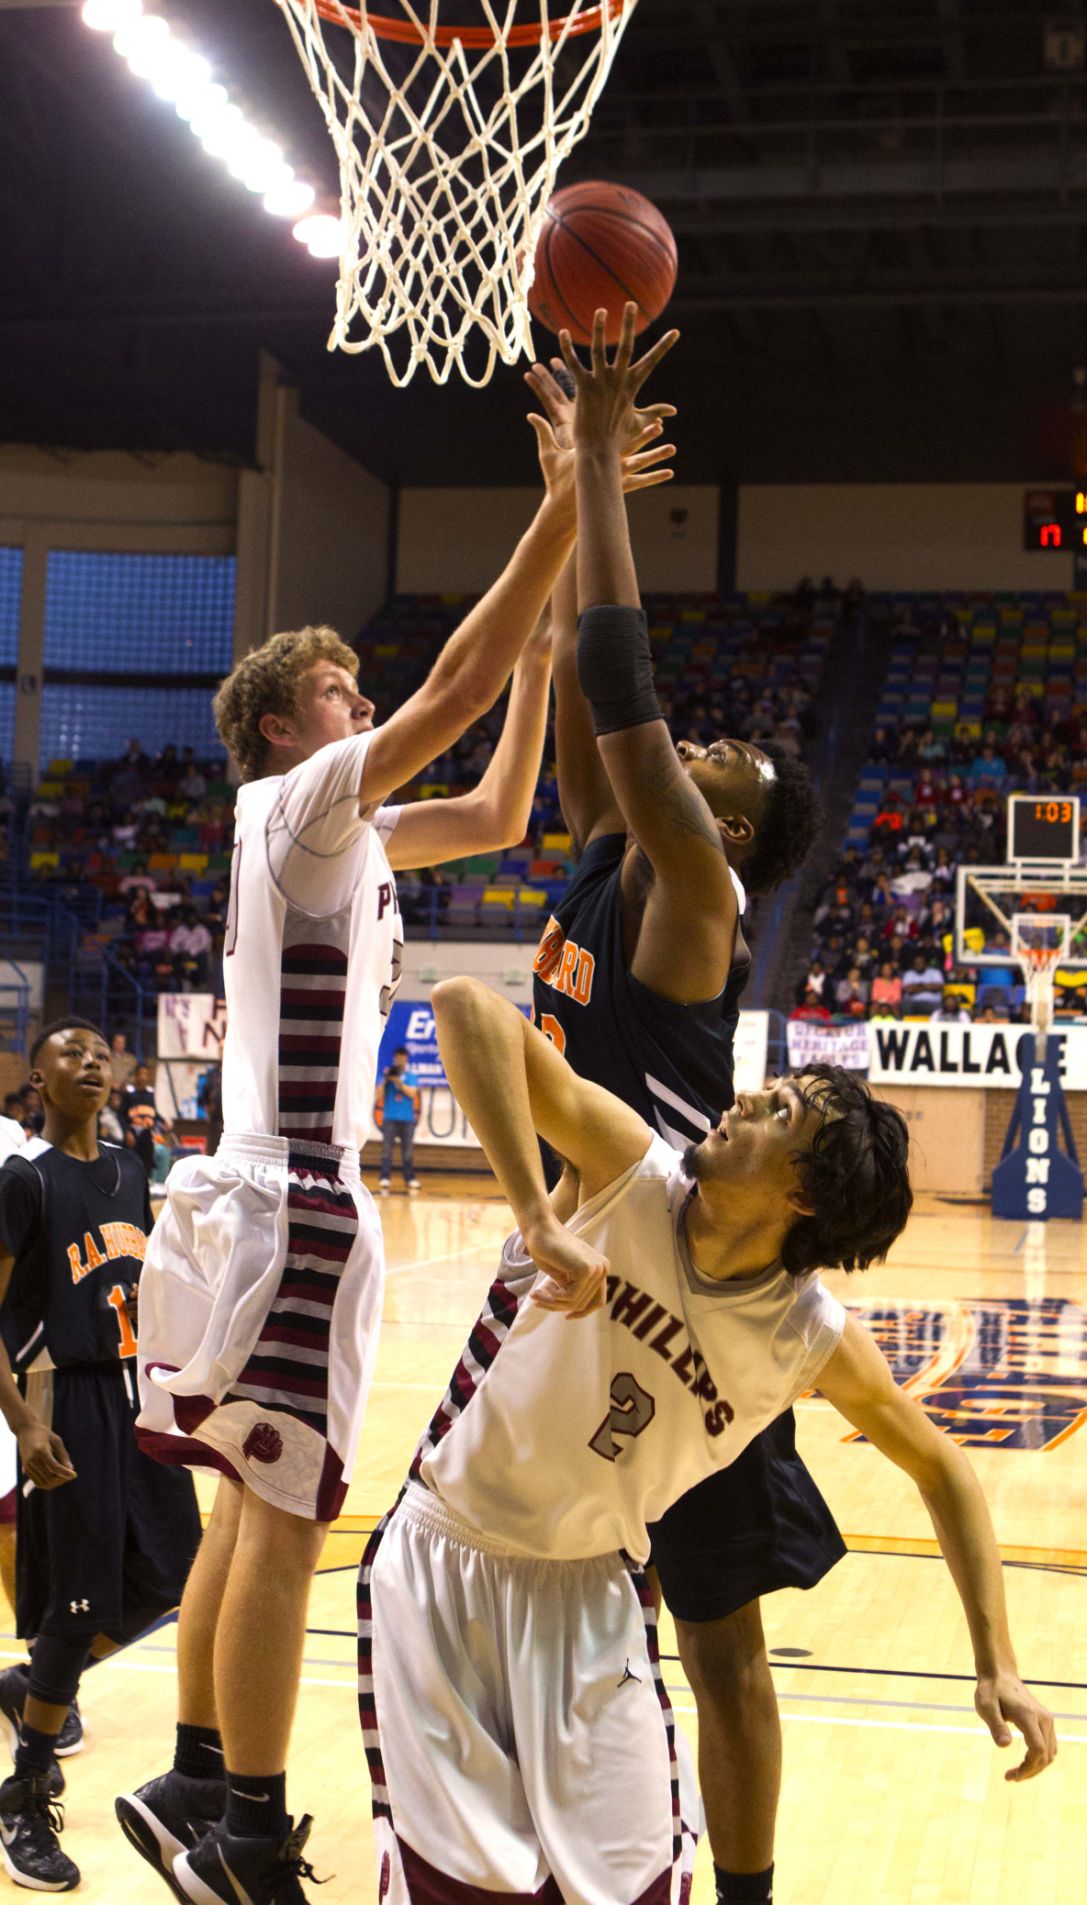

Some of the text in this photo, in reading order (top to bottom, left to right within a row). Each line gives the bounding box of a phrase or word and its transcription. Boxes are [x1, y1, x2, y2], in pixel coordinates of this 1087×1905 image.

[876, 1028, 1068, 1077] WALLA
[1025, 1068, 1051, 1214] LIONS
[588, 1372, 655, 1463] 2
